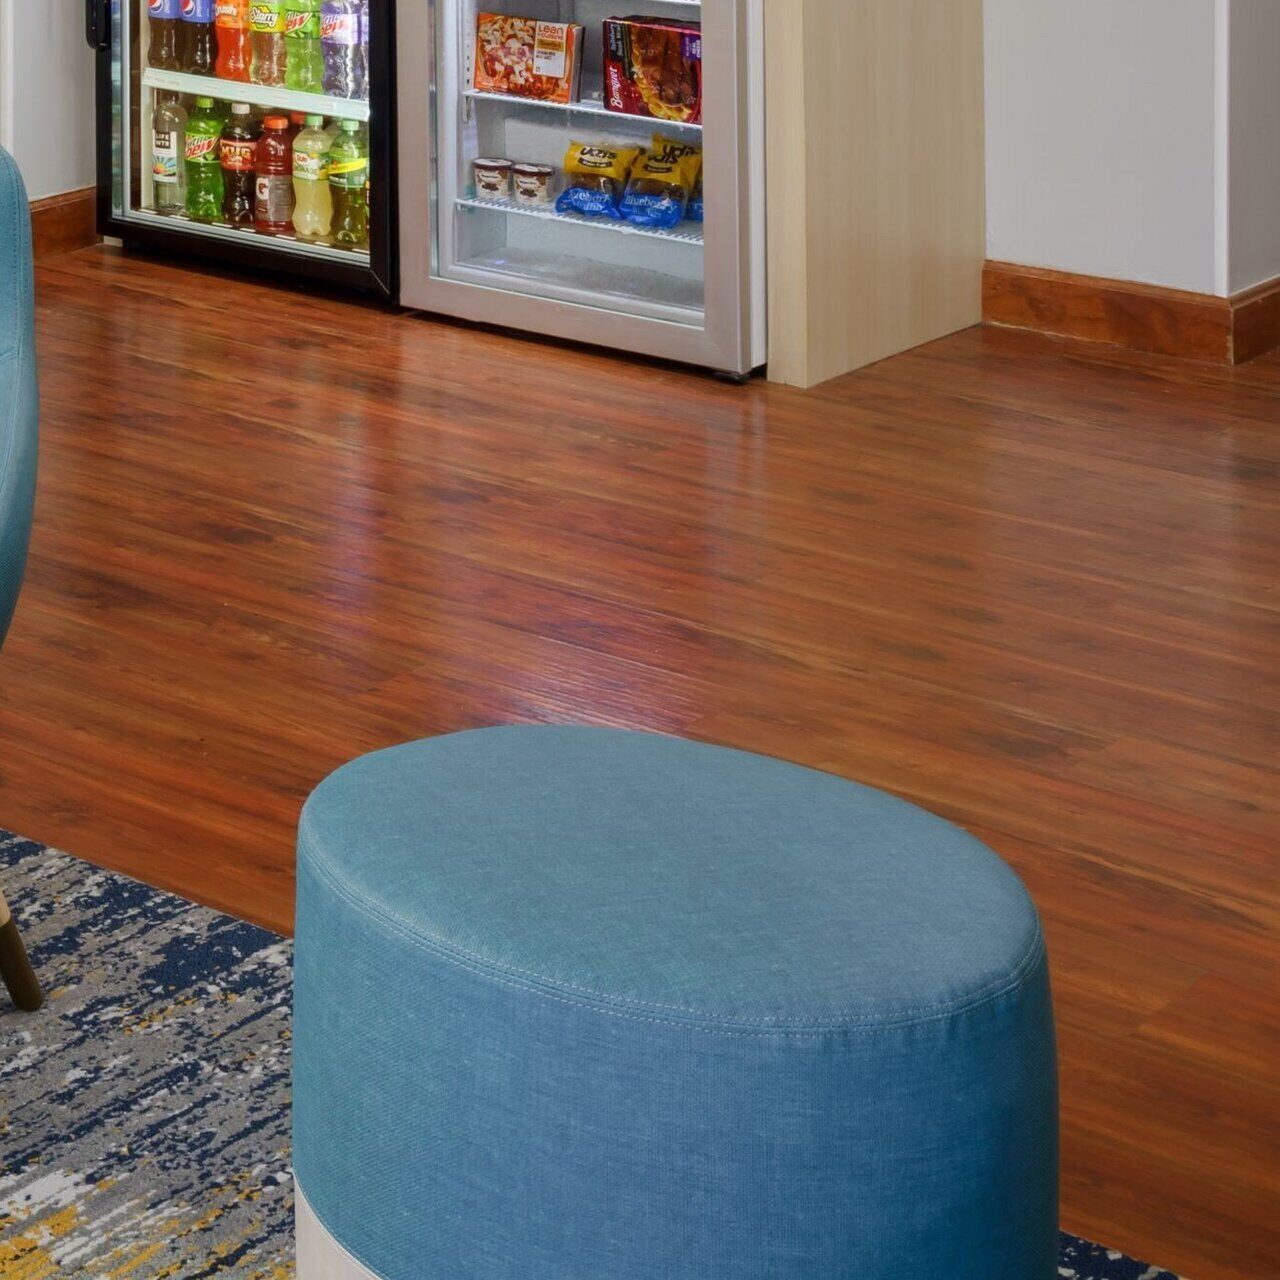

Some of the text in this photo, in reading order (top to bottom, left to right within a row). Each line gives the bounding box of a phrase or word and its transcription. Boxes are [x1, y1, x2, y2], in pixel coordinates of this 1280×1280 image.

[538, 25, 564, 35] Lean
[609, 66, 624, 109] Banquet
[222, 146, 251, 157] MUG
